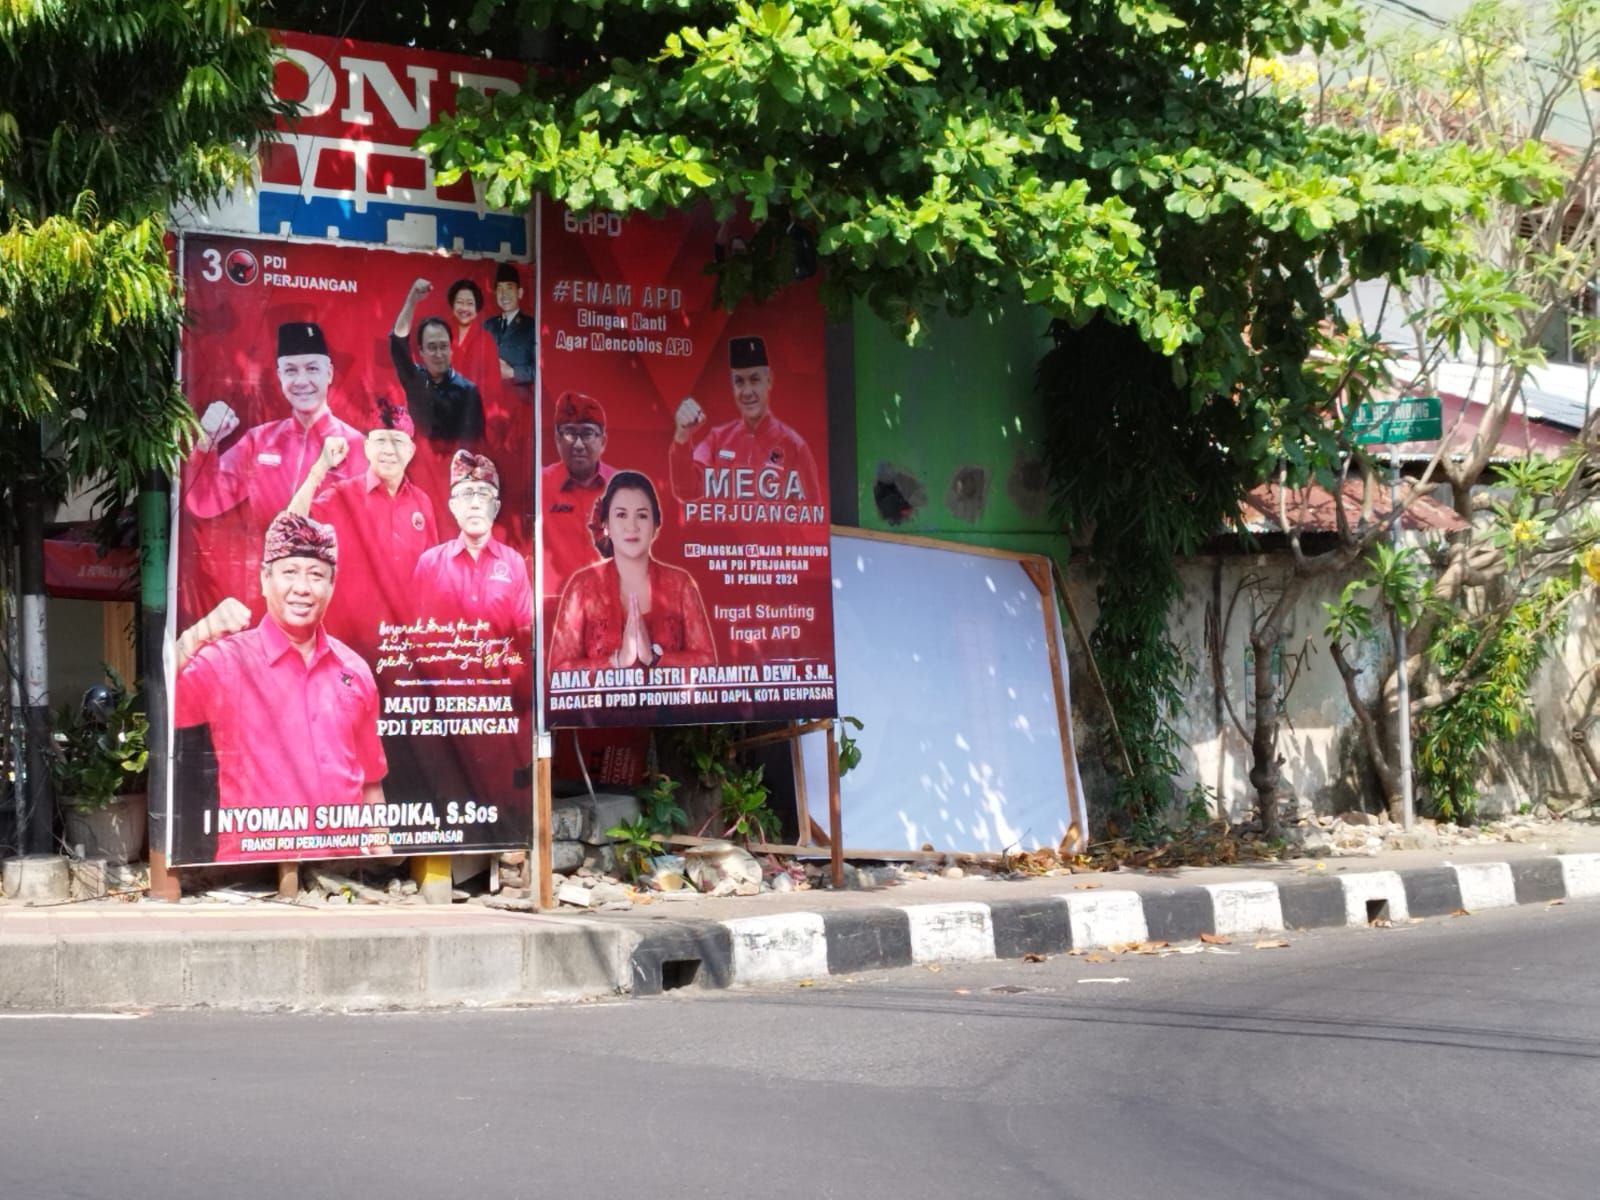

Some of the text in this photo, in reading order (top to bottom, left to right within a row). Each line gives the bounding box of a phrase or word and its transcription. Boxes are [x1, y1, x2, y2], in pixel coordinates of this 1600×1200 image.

[201, 248, 222, 282] 3
[263, 254, 287, 271] PDI
[263, 273, 358, 293] PERJUANGAN
[553, 280, 682, 309] #ENAM APD
[632, 312, 667, 331] Nanti
[556, 330, 693, 356] Agar Mencoblos APD
[703, 467, 806, 499] MEGA
[685, 503, 825, 523] PERJUANGAN
[684, 544, 829, 557] MENANGKAN GANJAR PRANOWO
[709, 559, 809, 571] DAN PDI PERJUANGAN
[724, 573, 798, 585] DI PEMILU 2024
[714, 604, 815, 621] Ingat Stunting
[730, 626, 801, 643] Ingat APD
[550, 668, 591, 689] ANAK
[595, 667, 645, 688] AGUNG
[648, 667, 684, 686] ISTRI
[689, 665, 758, 685] PARAMITA
[384, 696, 513, 715] MAJU BERSAMA
[550, 686, 834, 711] BACALEG DPRD PROVINSI BALI DAPIL KOTA DENPASAR
[376, 718, 519, 737] PDI PERJUANGAN
[203, 800, 498, 834] I NYOMAN SUMARDIKA, S.Sos
[241, 829, 464, 852] FRAKSI PDI PERJUANGAN DPRD KOTA DENPASAR
